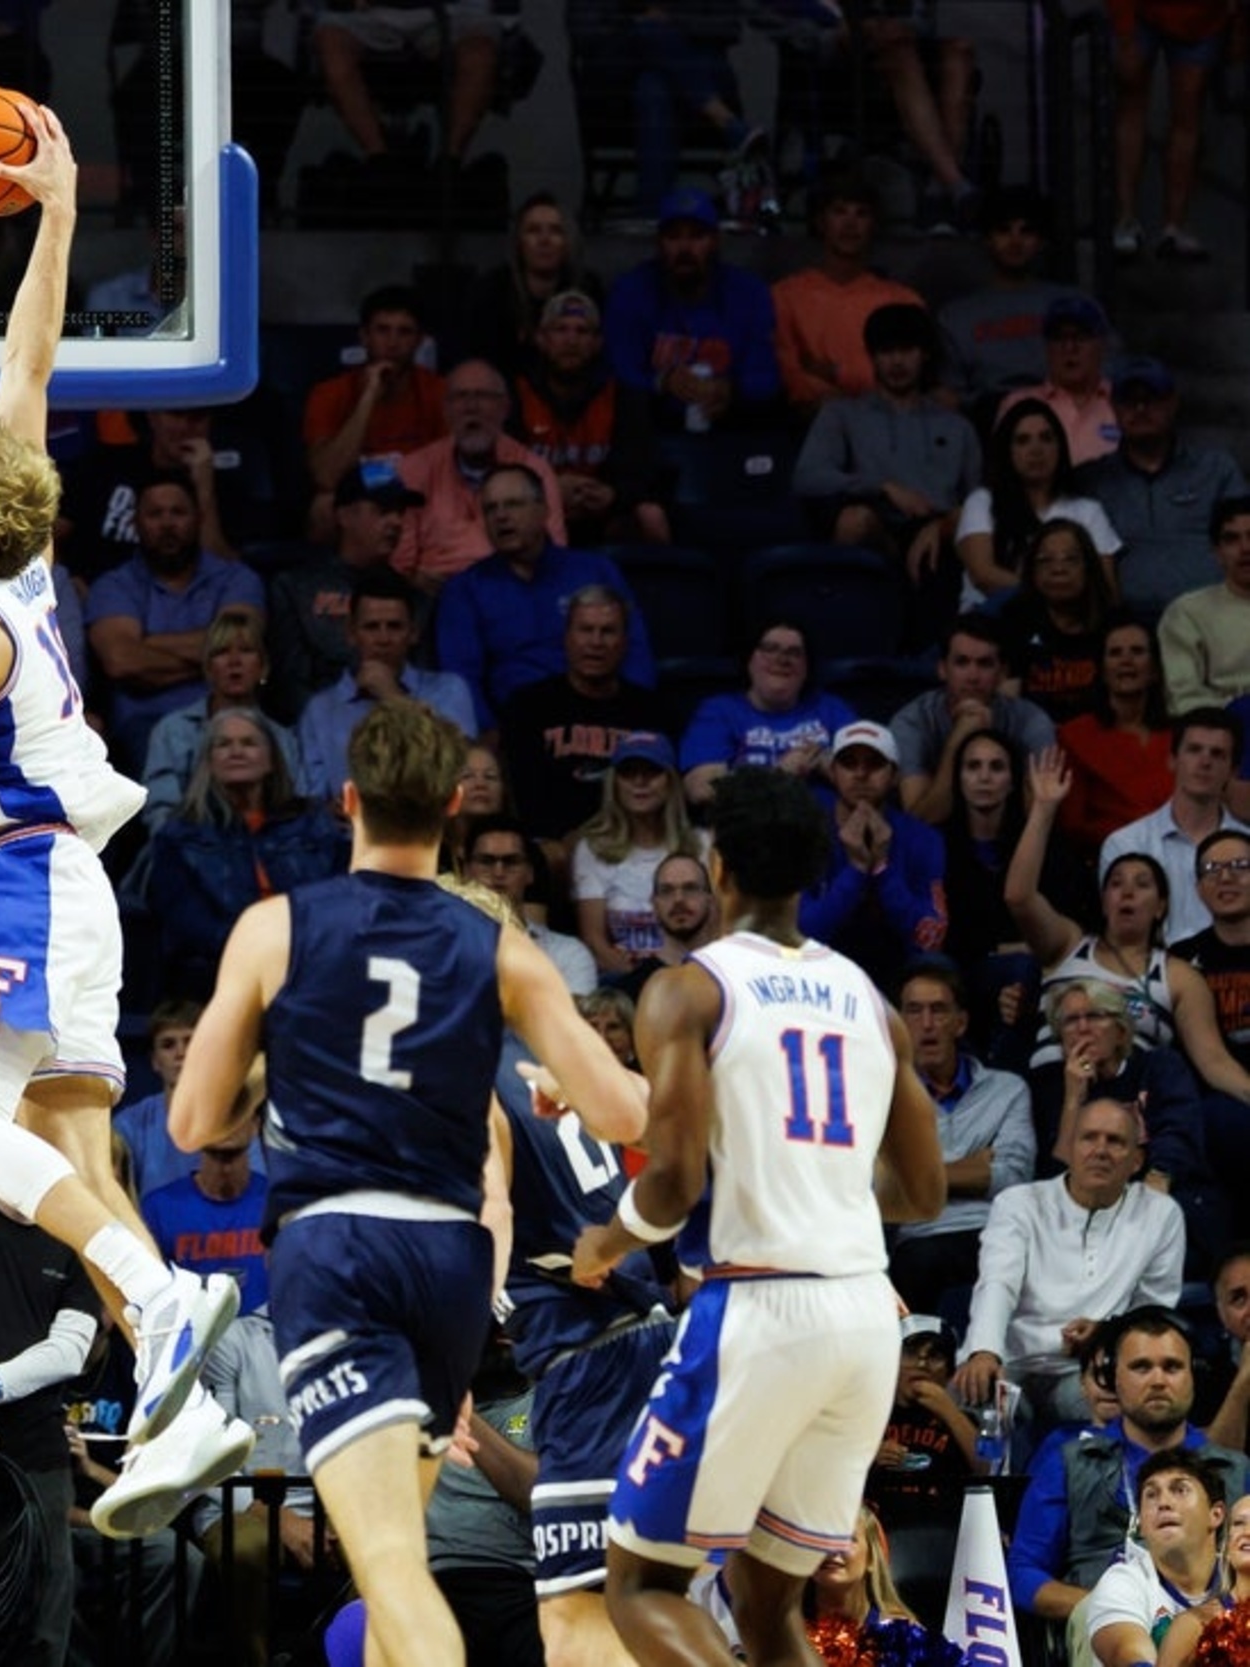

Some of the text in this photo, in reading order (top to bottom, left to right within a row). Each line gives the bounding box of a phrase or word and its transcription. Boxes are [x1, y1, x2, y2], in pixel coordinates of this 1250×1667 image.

[359, 956, 421, 1091] 2
[747, 975, 832, 1012] INGRAM
[780, 1028, 854, 1148] 11
[625, 1413, 686, 1489] F
